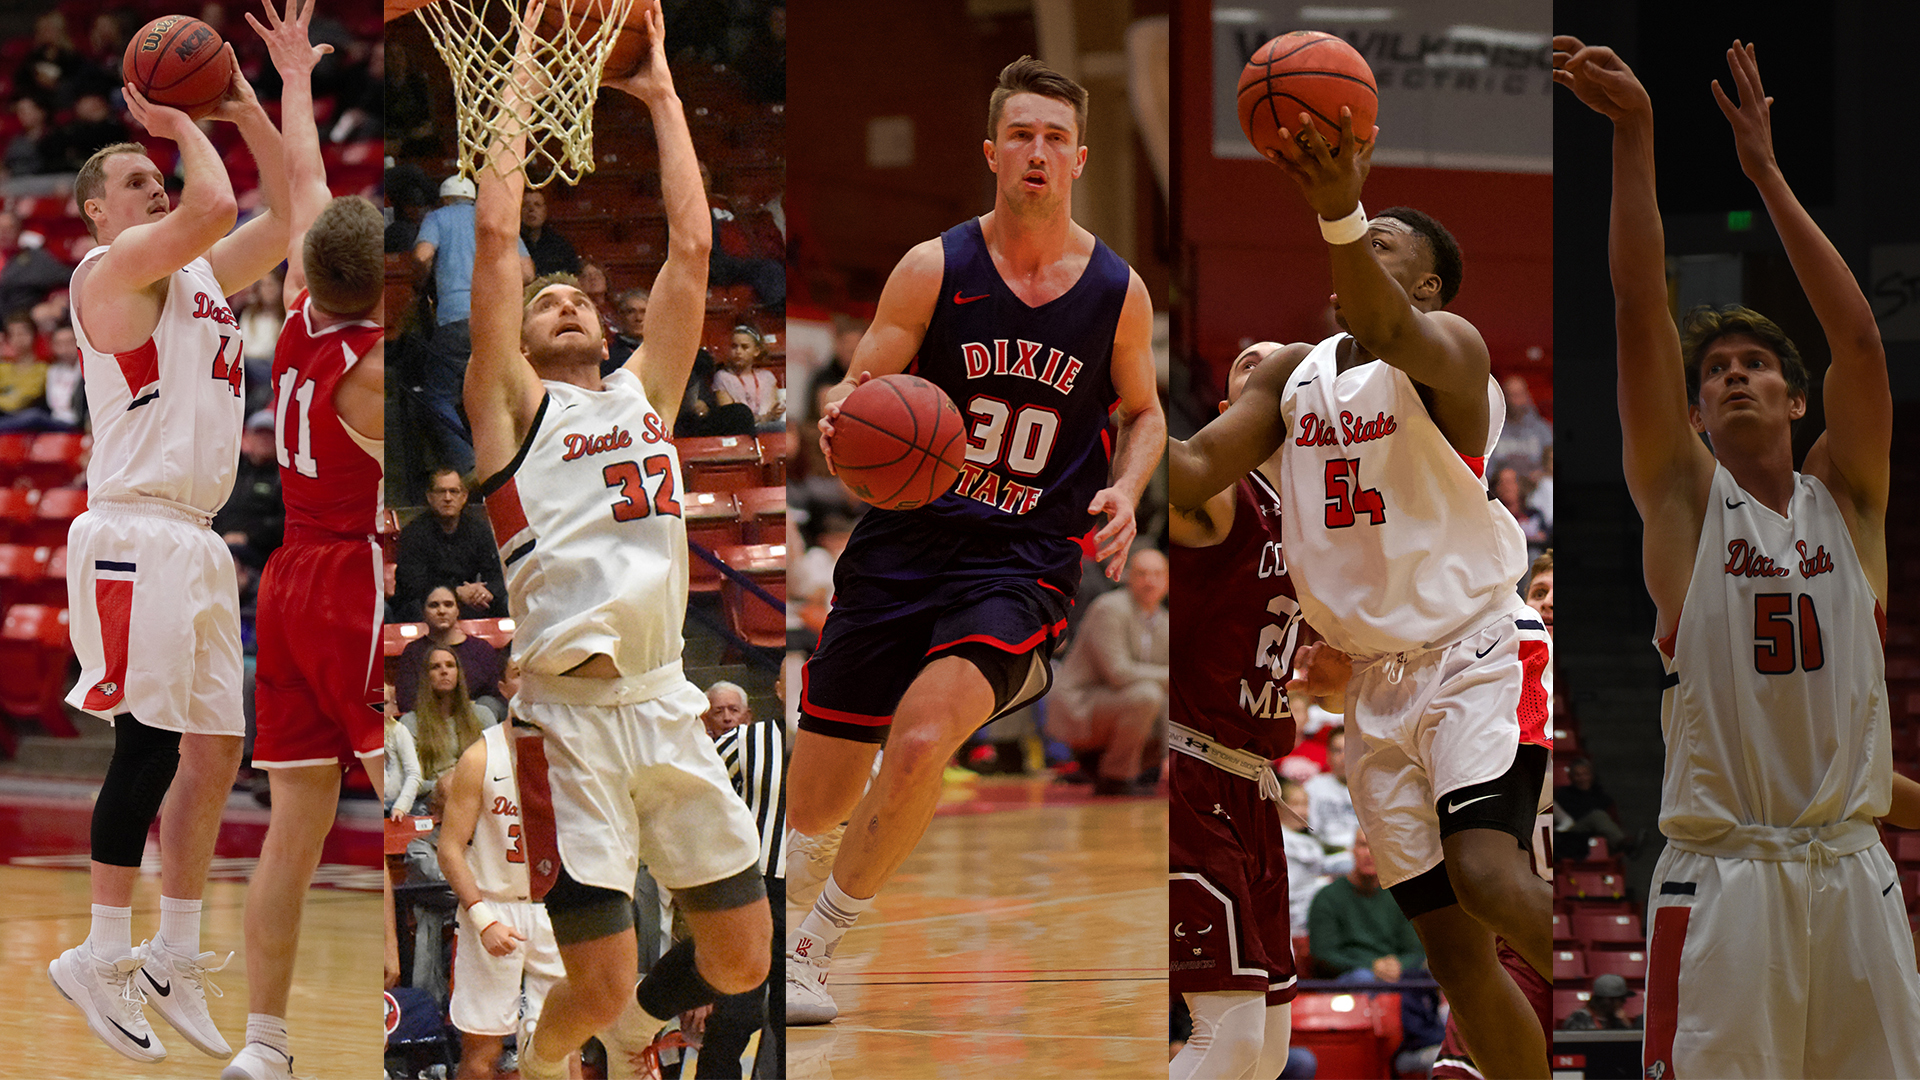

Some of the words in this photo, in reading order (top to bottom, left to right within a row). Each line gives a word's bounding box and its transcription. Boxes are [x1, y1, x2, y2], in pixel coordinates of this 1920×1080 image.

[175, 26, 214, 62] NCAA
[961, 338, 1083, 396] DIXIE
[278, 365, 319, 480] 11
[562, 425, 633, 462] Dixie
[964, 393, 1062, 478] 30
[1339, 410, 1398, 448] State
[602, 453, 681, 523] 32
[1324, 457, 1388, 530] 54
